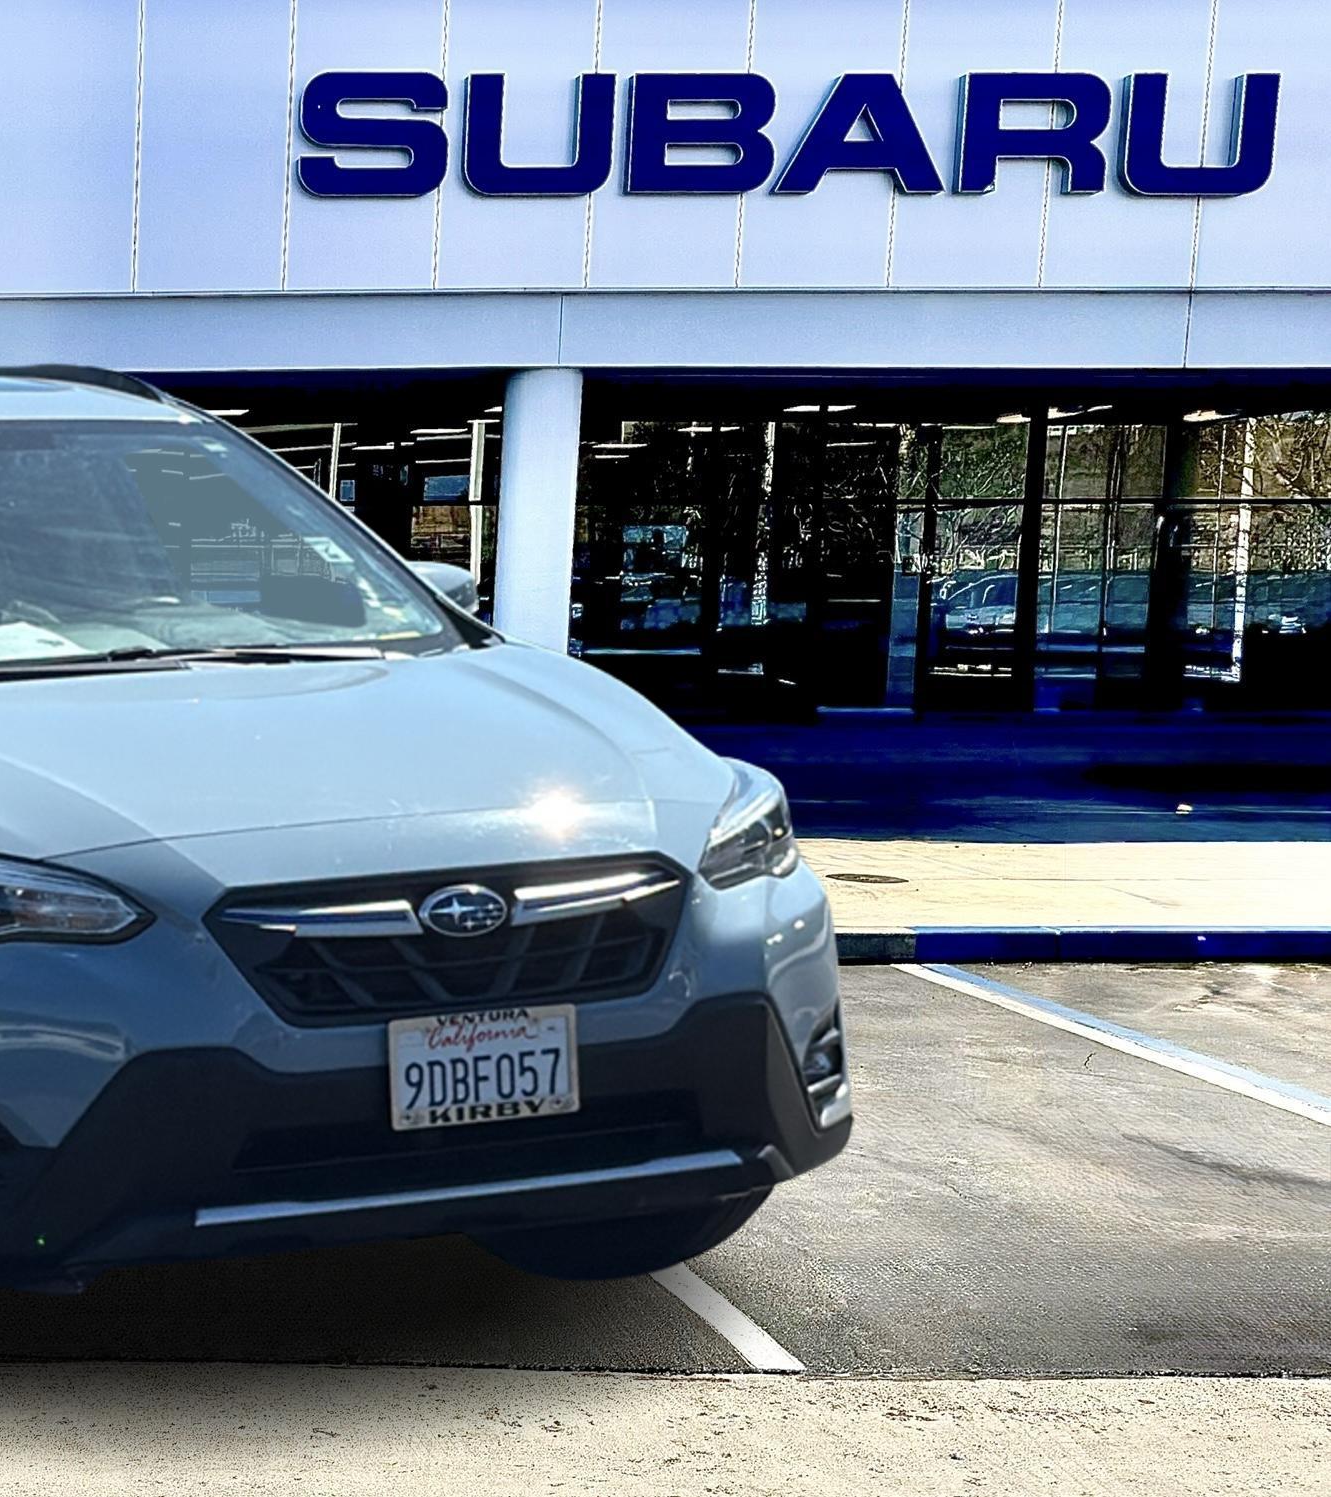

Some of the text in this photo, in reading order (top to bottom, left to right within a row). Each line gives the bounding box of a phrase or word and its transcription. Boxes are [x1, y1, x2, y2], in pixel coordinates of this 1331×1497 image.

[297, 71, 1281, 196] SUBARU
[437, 1009, 529, 1027] VENTURA
[427, 1024, 538, 1052] California
[404, 1048, 561, 1110] 9DBF057
[430, 1098, 545, 1124] KIRBY
